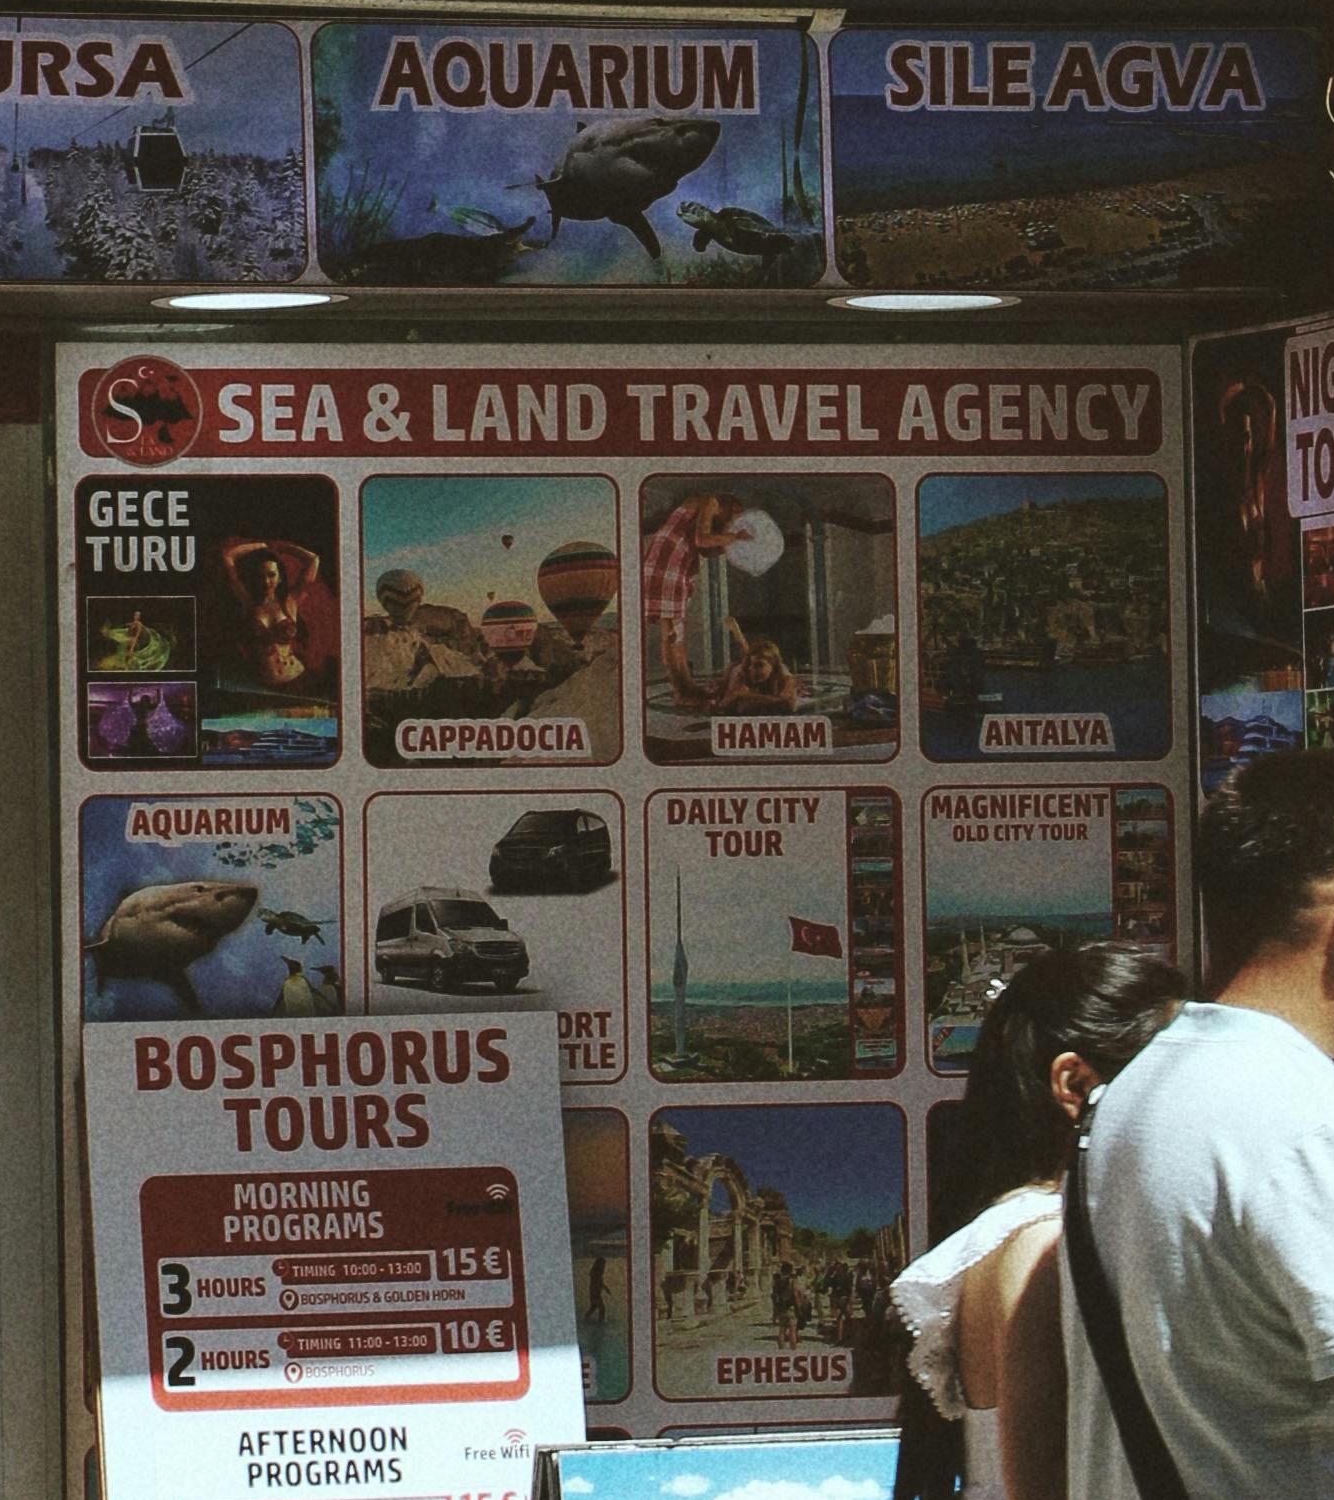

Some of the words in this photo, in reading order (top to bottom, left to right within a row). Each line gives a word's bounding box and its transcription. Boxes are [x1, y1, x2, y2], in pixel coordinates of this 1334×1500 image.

[379, 39, 756, 112] AQUARIUM
[887, 41, 1035, 109] SILE
[1046, 42, 1263, 113] AGVA
[217, 384, 344, 443] SEA
[362, 383, 413, 442] &
[433, 383, 607, 442] LAND
[626, 384, 879, 441] TRAVEL
[897, 384, 1151, 441] AGENCY
[88, 490, 190, 528] GECE
[86, 535, 196, 572] TURU
[401, 724, 585, 753] CAPPADOCIA
[717, 721, 826, 749] HAMAM
[985, 719, 1108, 747] ANTALYA
[667, 798, 744, 825] DAILY
[931, 794, 1109, 819] MAGNIFICENT
[132, 807, 291, 840] AQUARIUM
[134, 1029, 510, 1091] BOSPHORUS
[223, 1093, 429, 1153] TOURS
[234, 1181, 370, 1210] MORNING
[161, 1264, 192, 1315] 3
[717, 1355, 848, 1384] EPHESUS
[238, 1427, 408, 1457] AFTERNOON
[464, 1447, 497, 1461] Free
[247, 1459, 403, 1488] PROGRAMS
